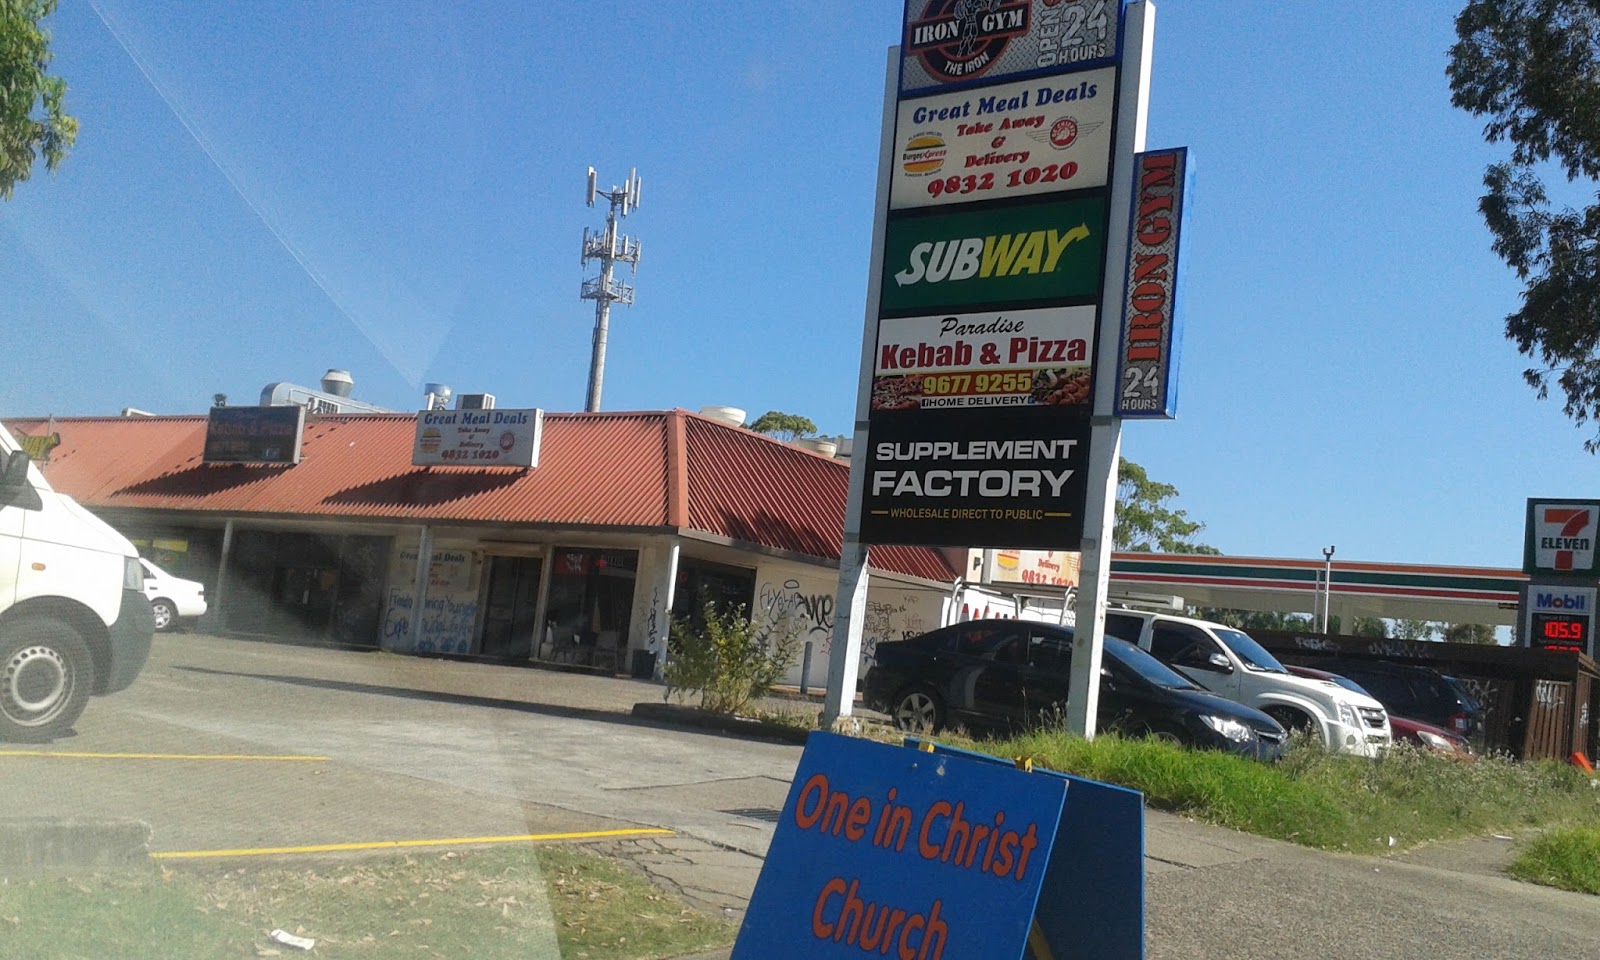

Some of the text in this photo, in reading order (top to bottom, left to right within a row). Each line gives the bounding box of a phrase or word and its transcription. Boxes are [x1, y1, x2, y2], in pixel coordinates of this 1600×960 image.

[913, 9, 1024, 45] IRON GYM
[1036, 8, 1061, 68] OPEN
[1061, 2, 1107, 47] 24
[943, 51, 990, 76] THE IRON
[1058, 43, 1106, 65] HOURS
[913, 81, 1097, 124] Great Meal Deals
[957, 122, 993, 137] Take
[998, 115, 1045, 131] Away
[964, 151, 1030, 168] Delivery
[927, 161, 1078, 198] 9832 1020
[894, 223, 1089, 287] SUBWAY
[1128, 153, 1177, 361] IRON GYM
[940, 316, 1025, 338] Paradise
[880, 335, 1087, 370] Kebab & Pizza
[923, 372, 1033, 395] 9677 9255
[1123, 365, 1160, 398] 24
[928, 395, 1027, 408] HOME DELIVERY
[1121, 399, 1157, 410] HOURS
[424, 411, 529, 425] Great Meal Deals
[875, 439, 1078, 461] SUPPLEMENT
[872, 469, 1075, 498] FACTORY
[890, 508, 1044, 520] WHOLESALE DIRECT TO PUBLIC
[1536, 593, 1585, 609] Mobil
[796, 774, 1038, 880] One in Christ
[812, 877, 949, 960] Church
